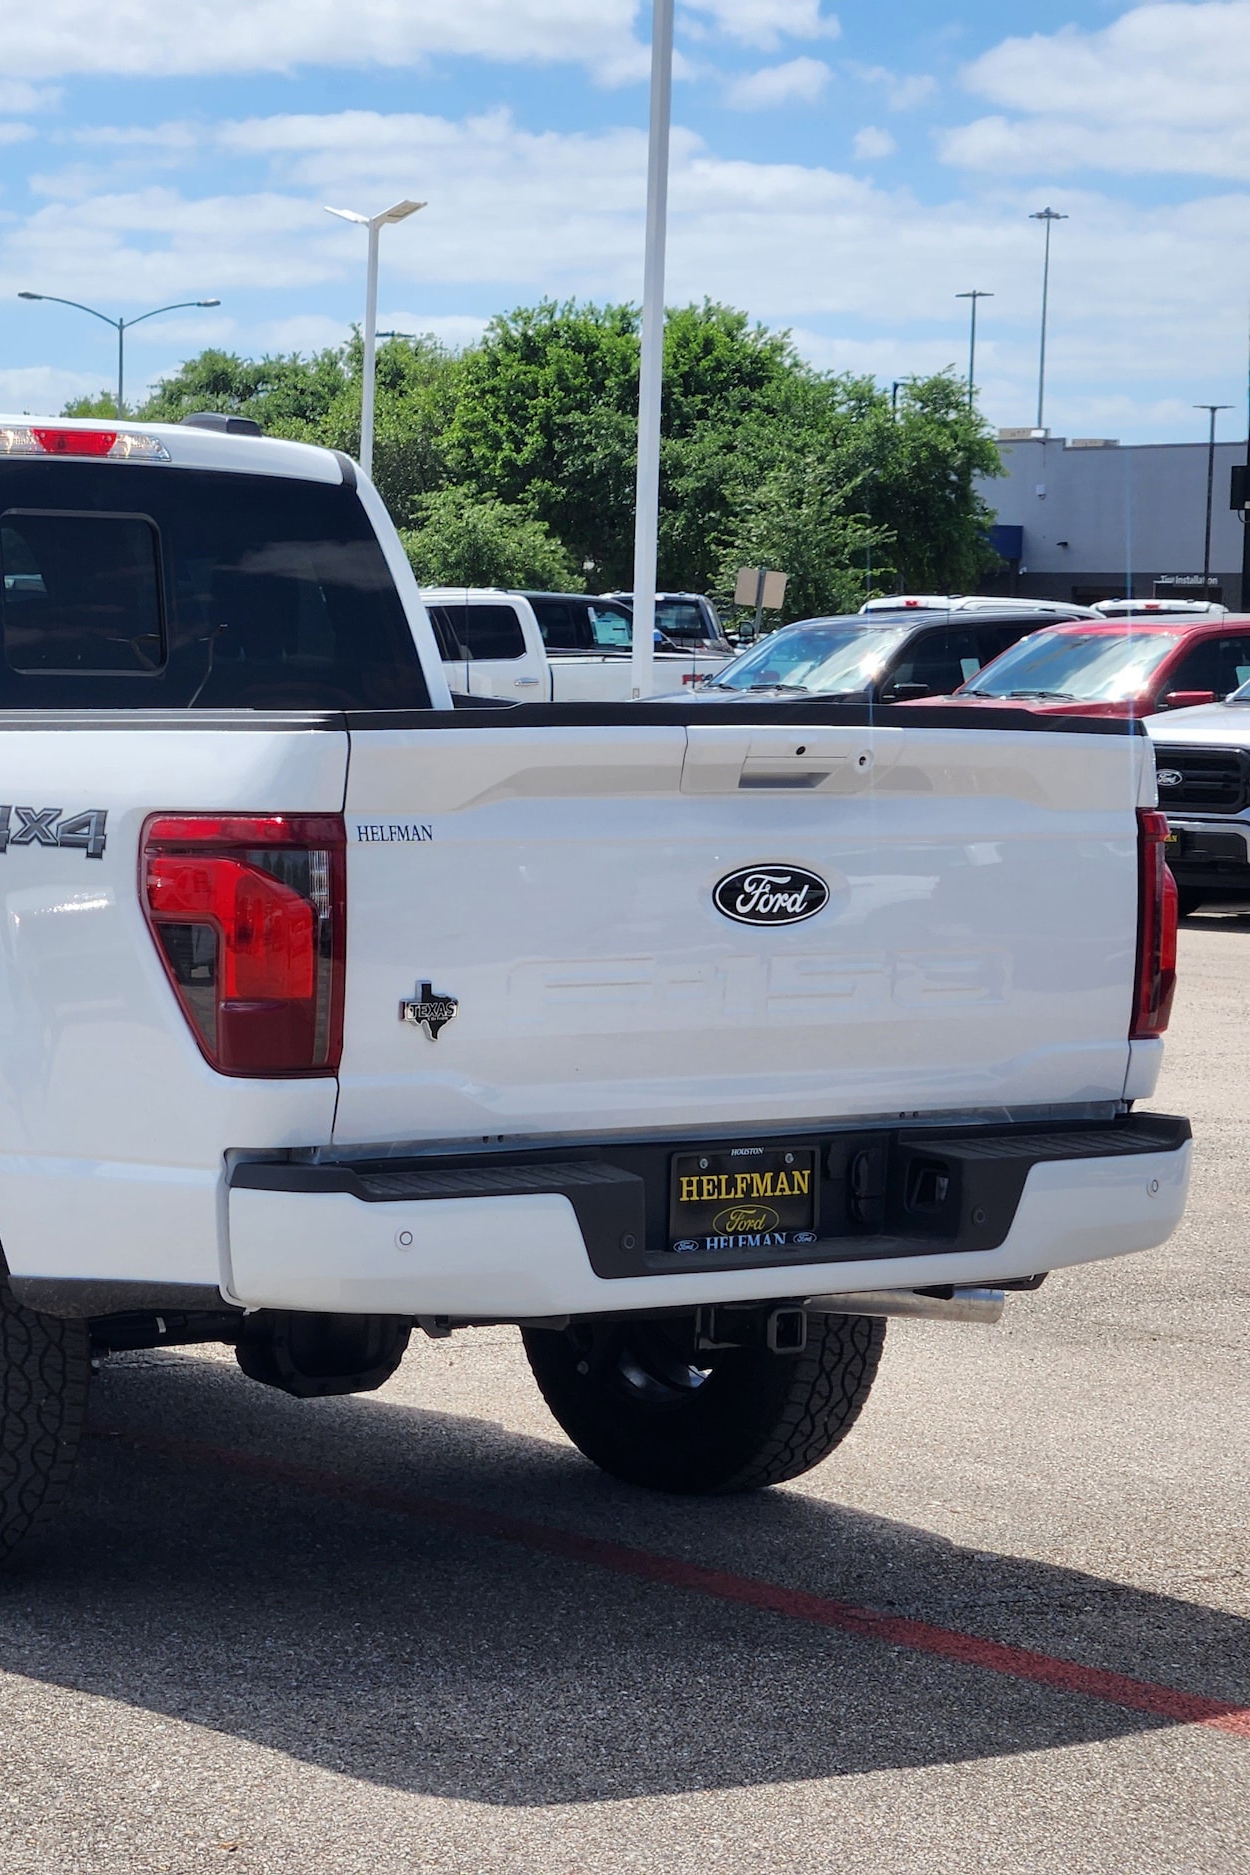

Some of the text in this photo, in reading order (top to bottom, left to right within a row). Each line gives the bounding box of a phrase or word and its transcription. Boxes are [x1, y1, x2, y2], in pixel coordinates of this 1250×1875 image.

[1175, 575, 1218, 585] Installaton
[356, 825, 433, 842] HELFMAN
[736, 874, 809, 914] Ford
[409, 1002, 456, 1017] TEXAS
[730, 1147, 764, 1157] HOUSTON
[679, 1170, 811, 1201] HELFMAN
[726, 1209, 767, 1232] Ford
